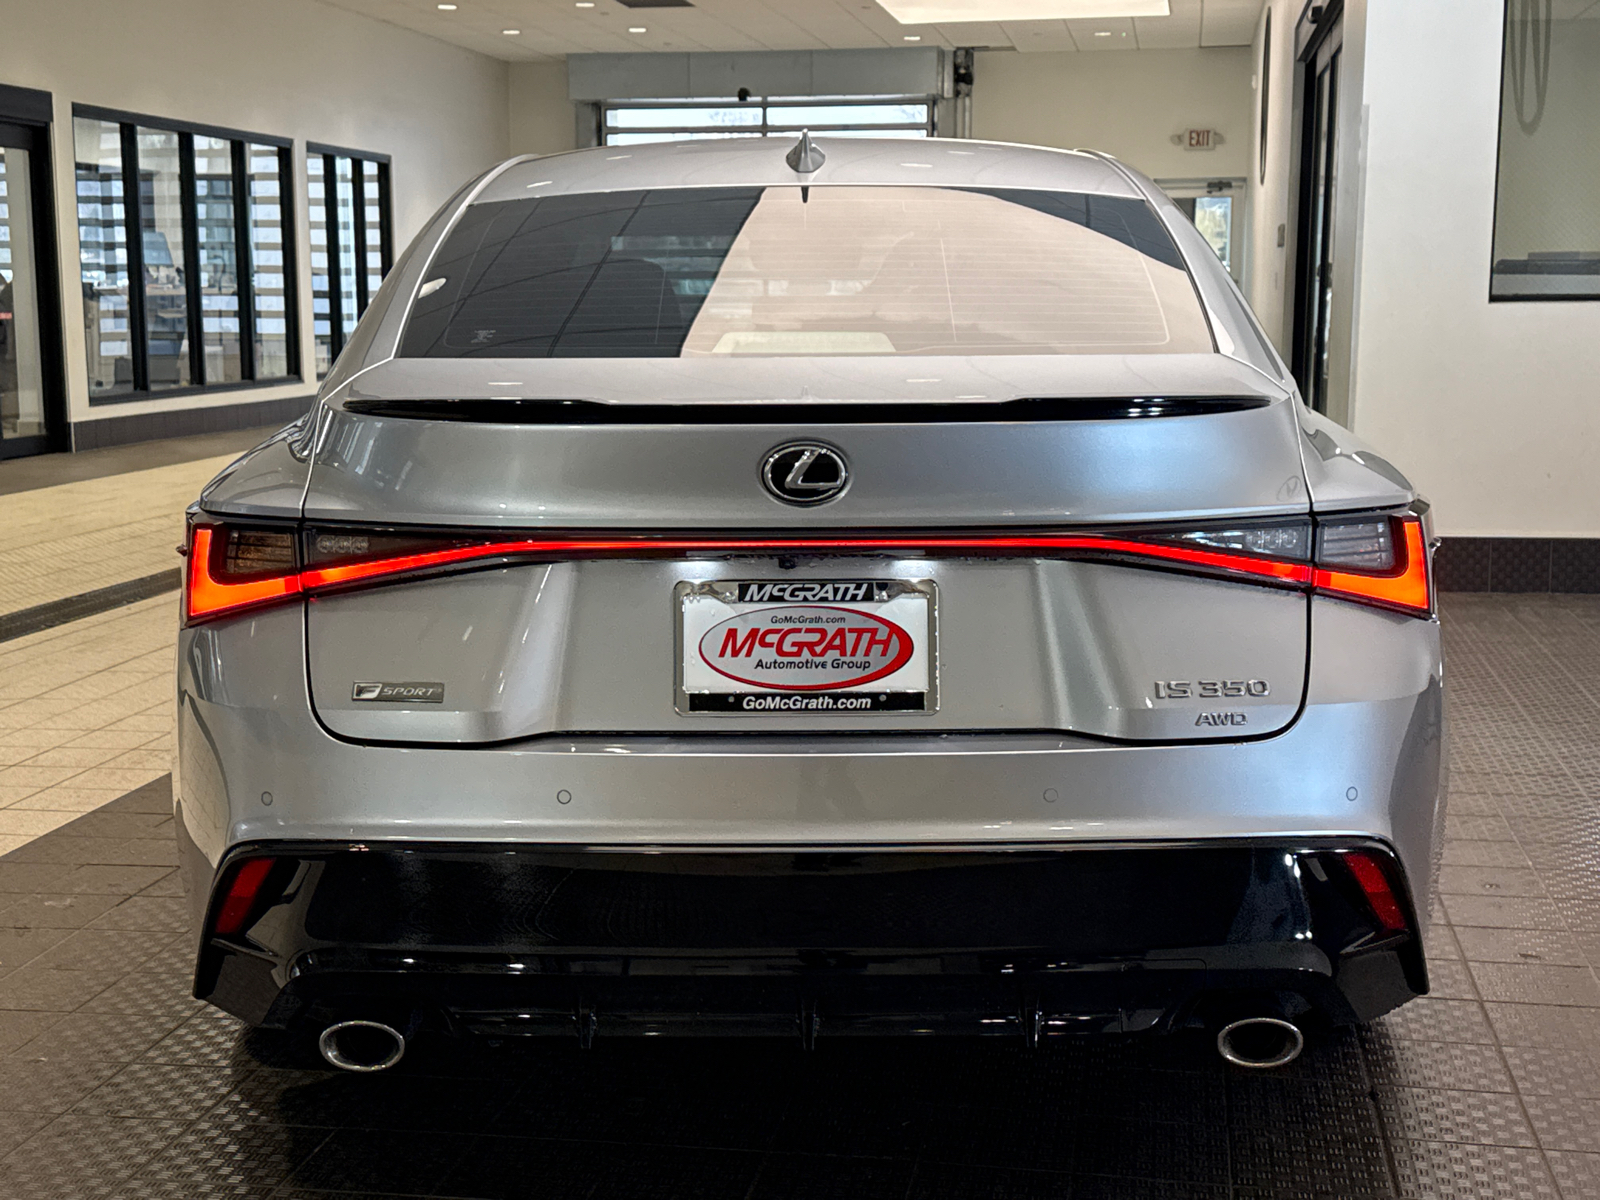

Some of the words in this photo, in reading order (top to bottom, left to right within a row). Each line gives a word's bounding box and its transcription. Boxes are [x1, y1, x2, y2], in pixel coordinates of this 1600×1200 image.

[1189, 130, 1210, 146] EXIT
[770, 615, 846, 624] GoMcGrath.com
[754, 658, 827, 670] Automotive
[831, 658, 871, 671] Group
[382, 687, 434, 696] SPORT
[1155, 681, 1193, 699] IS
[1198, 680, 1271, 697] 350
[742, 696, 871, 710] GoMcGrath.com
[1195, 712, 1248, 726] AWD
